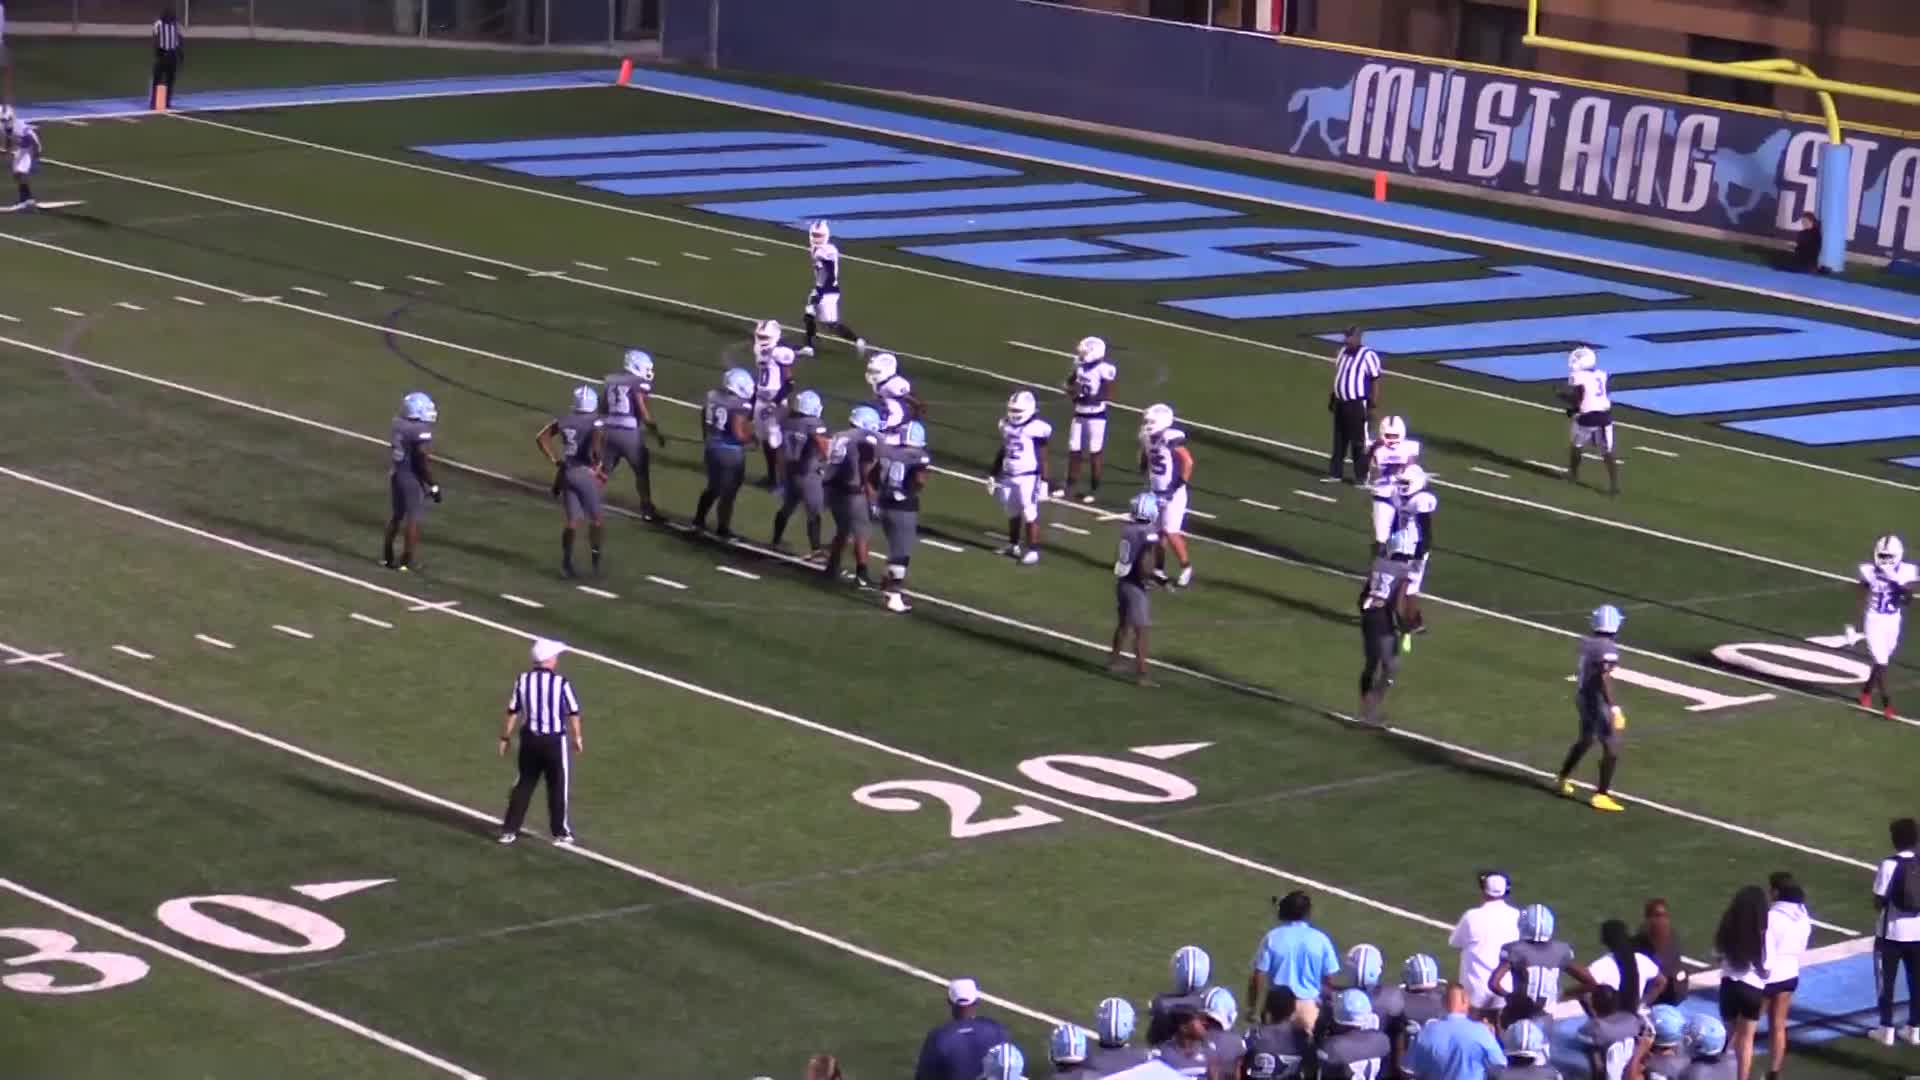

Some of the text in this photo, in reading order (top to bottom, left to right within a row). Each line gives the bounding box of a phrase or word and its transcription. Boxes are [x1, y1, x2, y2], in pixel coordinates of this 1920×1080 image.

[1345, 62, 1720, 214] MUSTANG
[412, 130, 1920, 470] MUSTA
[1564, 643, 1873, 711] 10
[851, 754, 1198, 838] 20
[0, 894, 346, 995] 30
